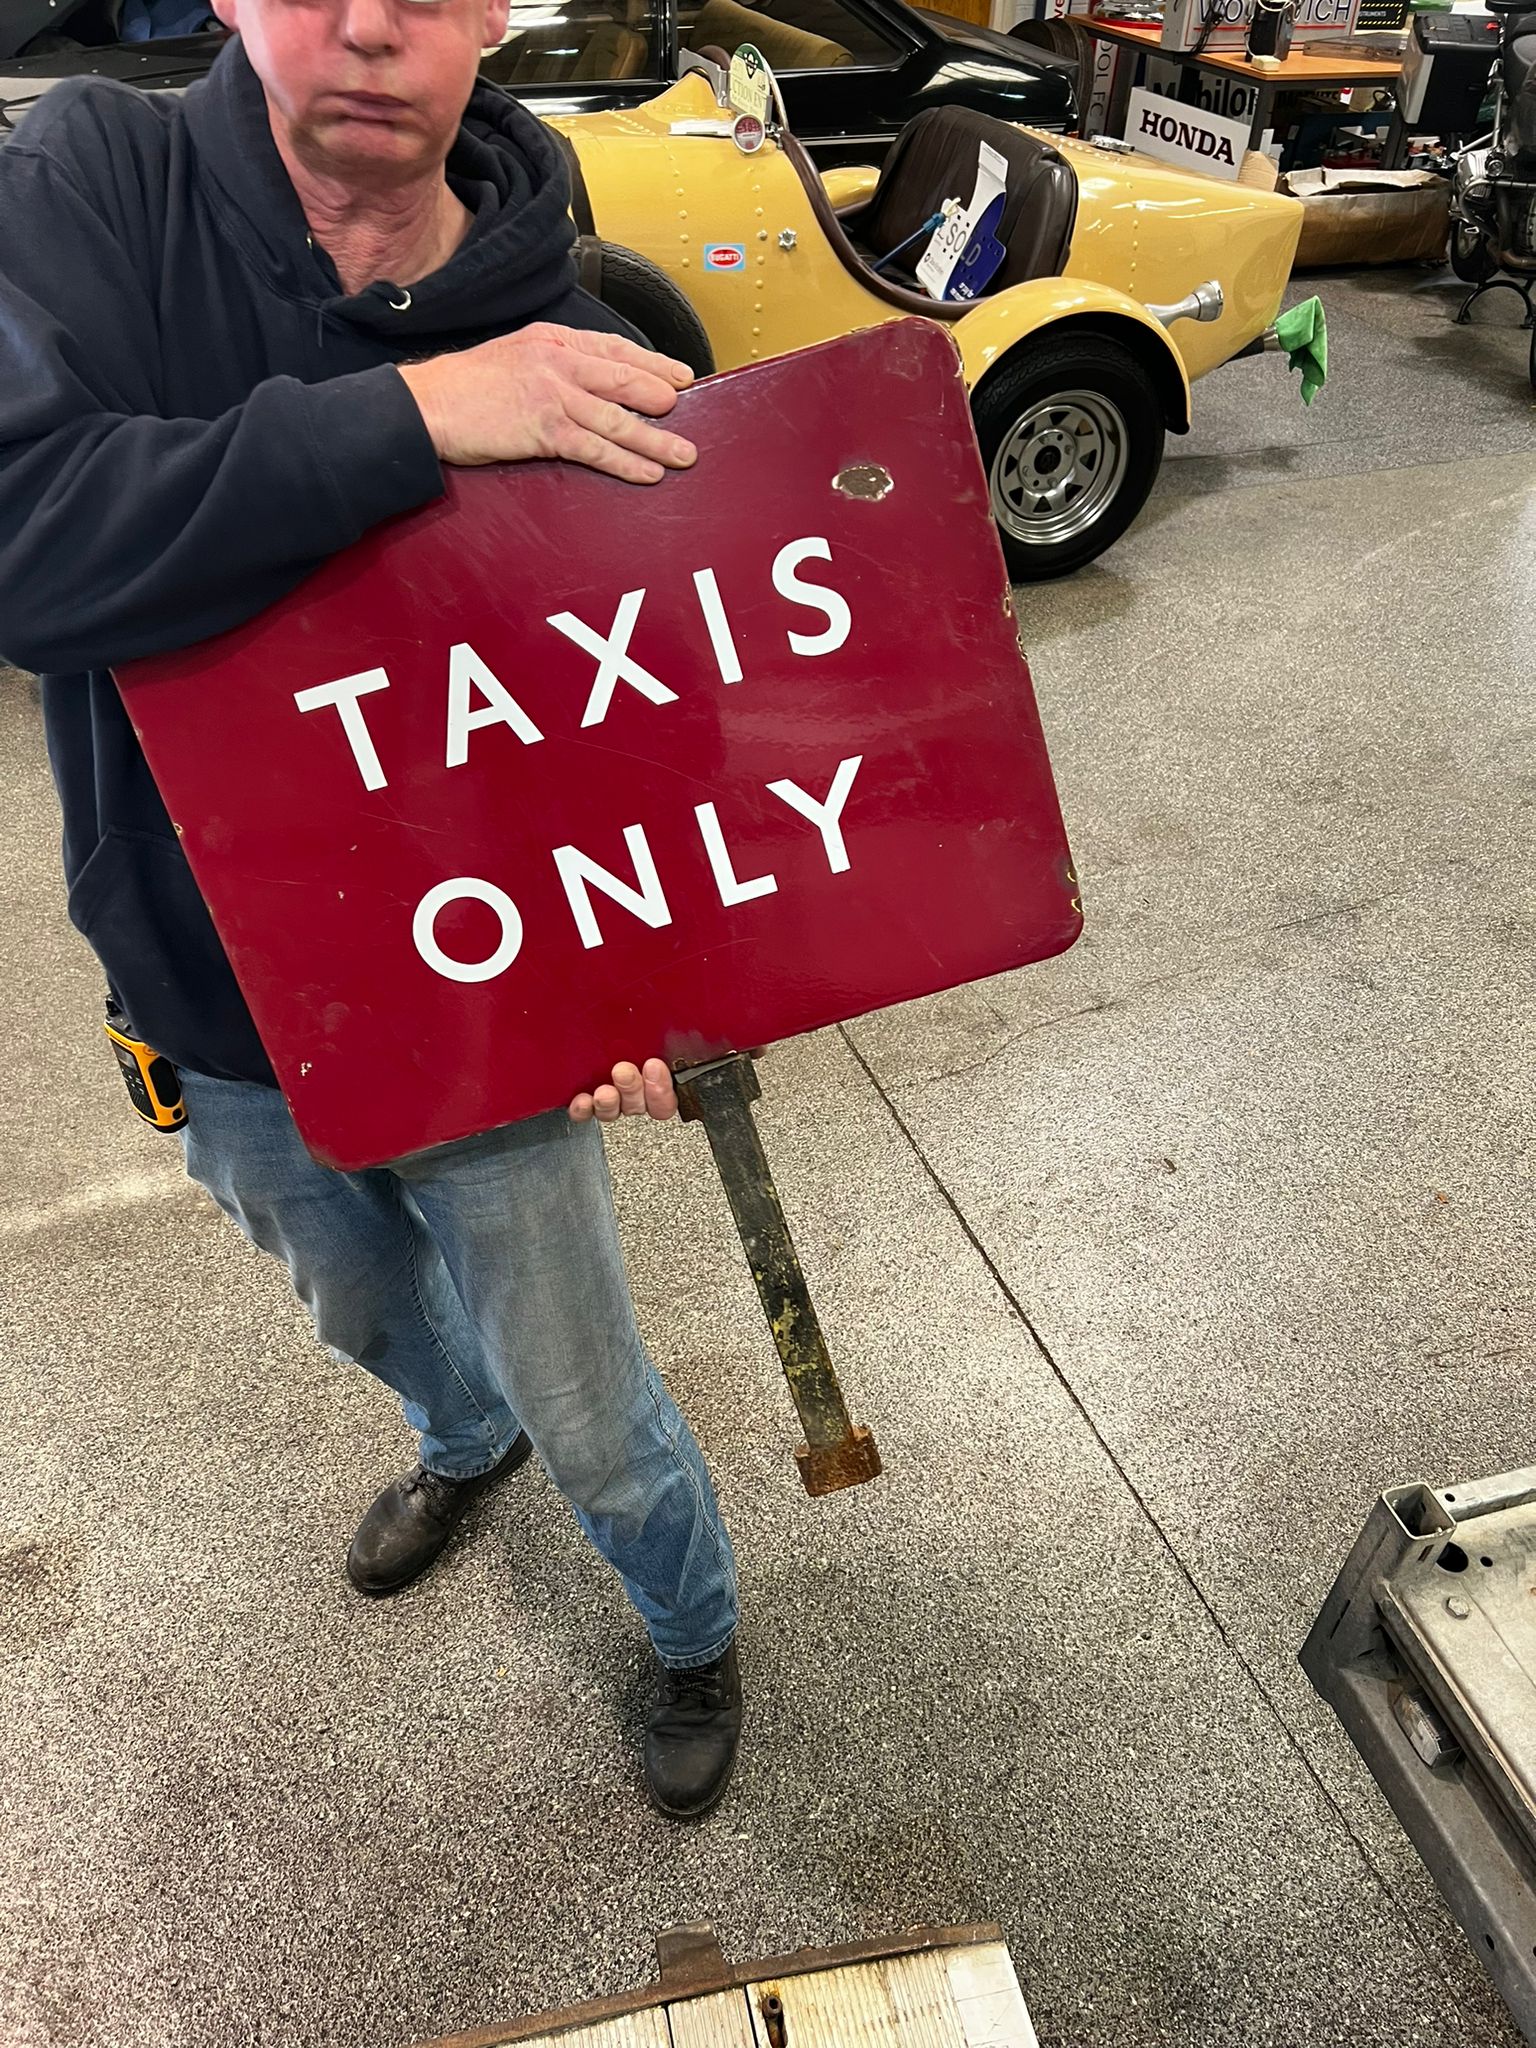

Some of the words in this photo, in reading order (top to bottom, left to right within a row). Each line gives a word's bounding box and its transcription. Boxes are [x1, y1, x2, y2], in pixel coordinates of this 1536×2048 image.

[1199, 0, 1350, 23] WOICH
[1089, 91, 1106, 117] FC
[1139, 109, 1235, 166] HONDA
[293, 536, 853, 792] TAXIS
[412, 755, 864, 983] ONLY
